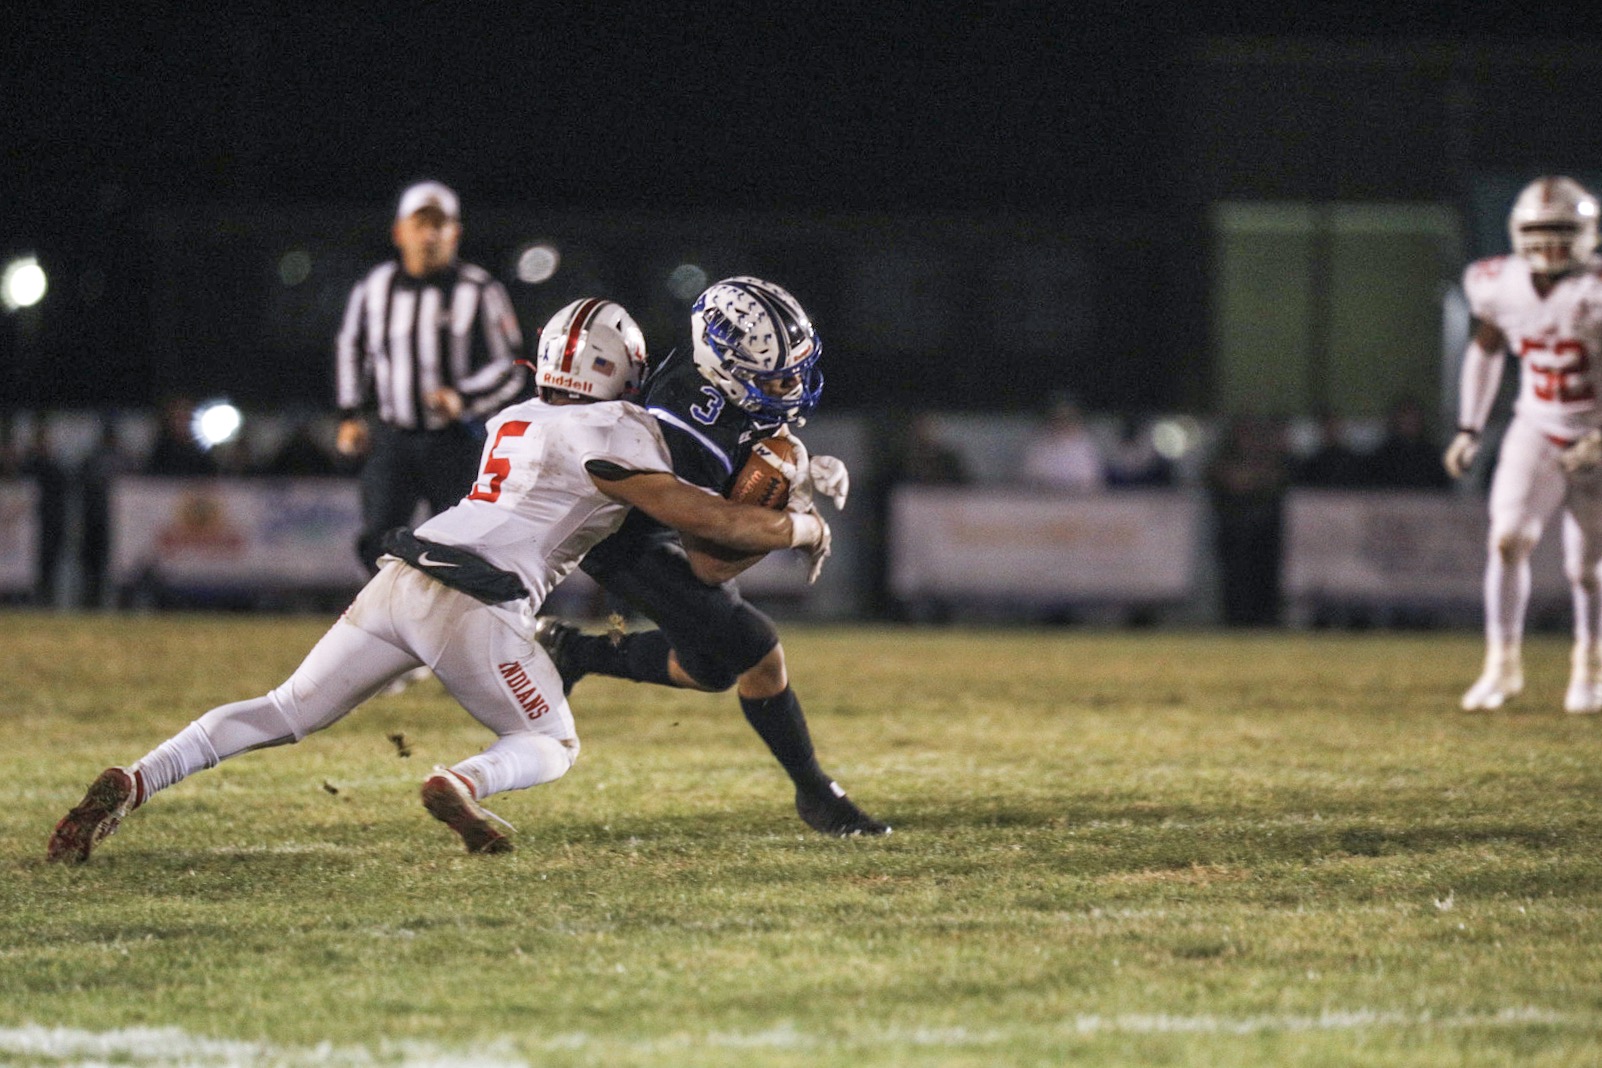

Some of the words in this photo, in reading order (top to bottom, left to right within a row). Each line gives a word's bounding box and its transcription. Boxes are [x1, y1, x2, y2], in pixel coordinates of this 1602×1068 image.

[543, 373, 593, 392] Riddell
[1521, 339, 1596, 402] 52
[690, 385, 725, 425] 3
[467, 421, 532, 503] 5
[499, 661, 549, 720] INDIANS
